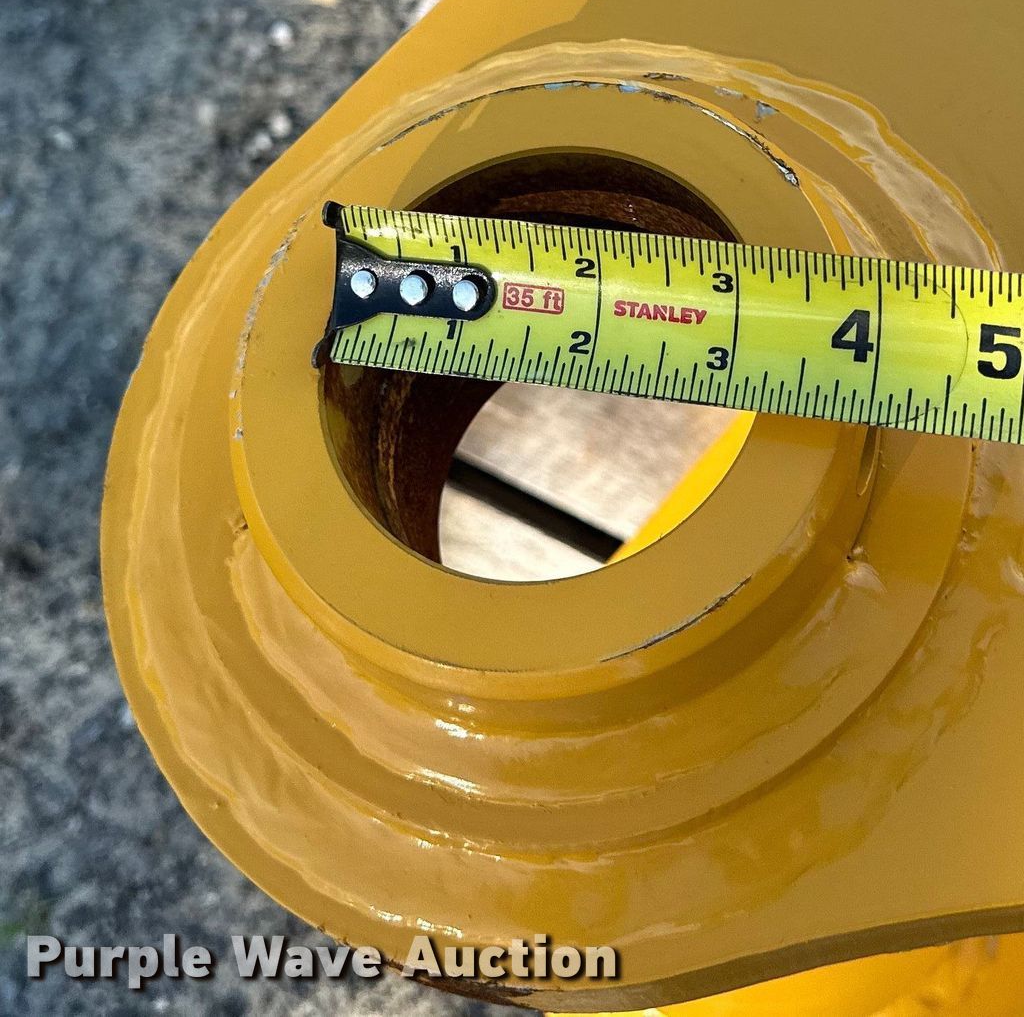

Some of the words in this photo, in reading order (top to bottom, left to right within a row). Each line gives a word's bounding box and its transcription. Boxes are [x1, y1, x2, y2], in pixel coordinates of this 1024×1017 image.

[575, 258, 596, 279] 2
[712, 272, 734, 294] 3
[506, 287, 537, 308] 35
[541, 290, 563, 313] ft
[614, 300, 707, 326] STANLEY
[569, 331, 592, 354] 2
[831, 309, 874, 363] 4
[706, 347, 729, 371] 3
[977, 323, 1022, 380] 5
